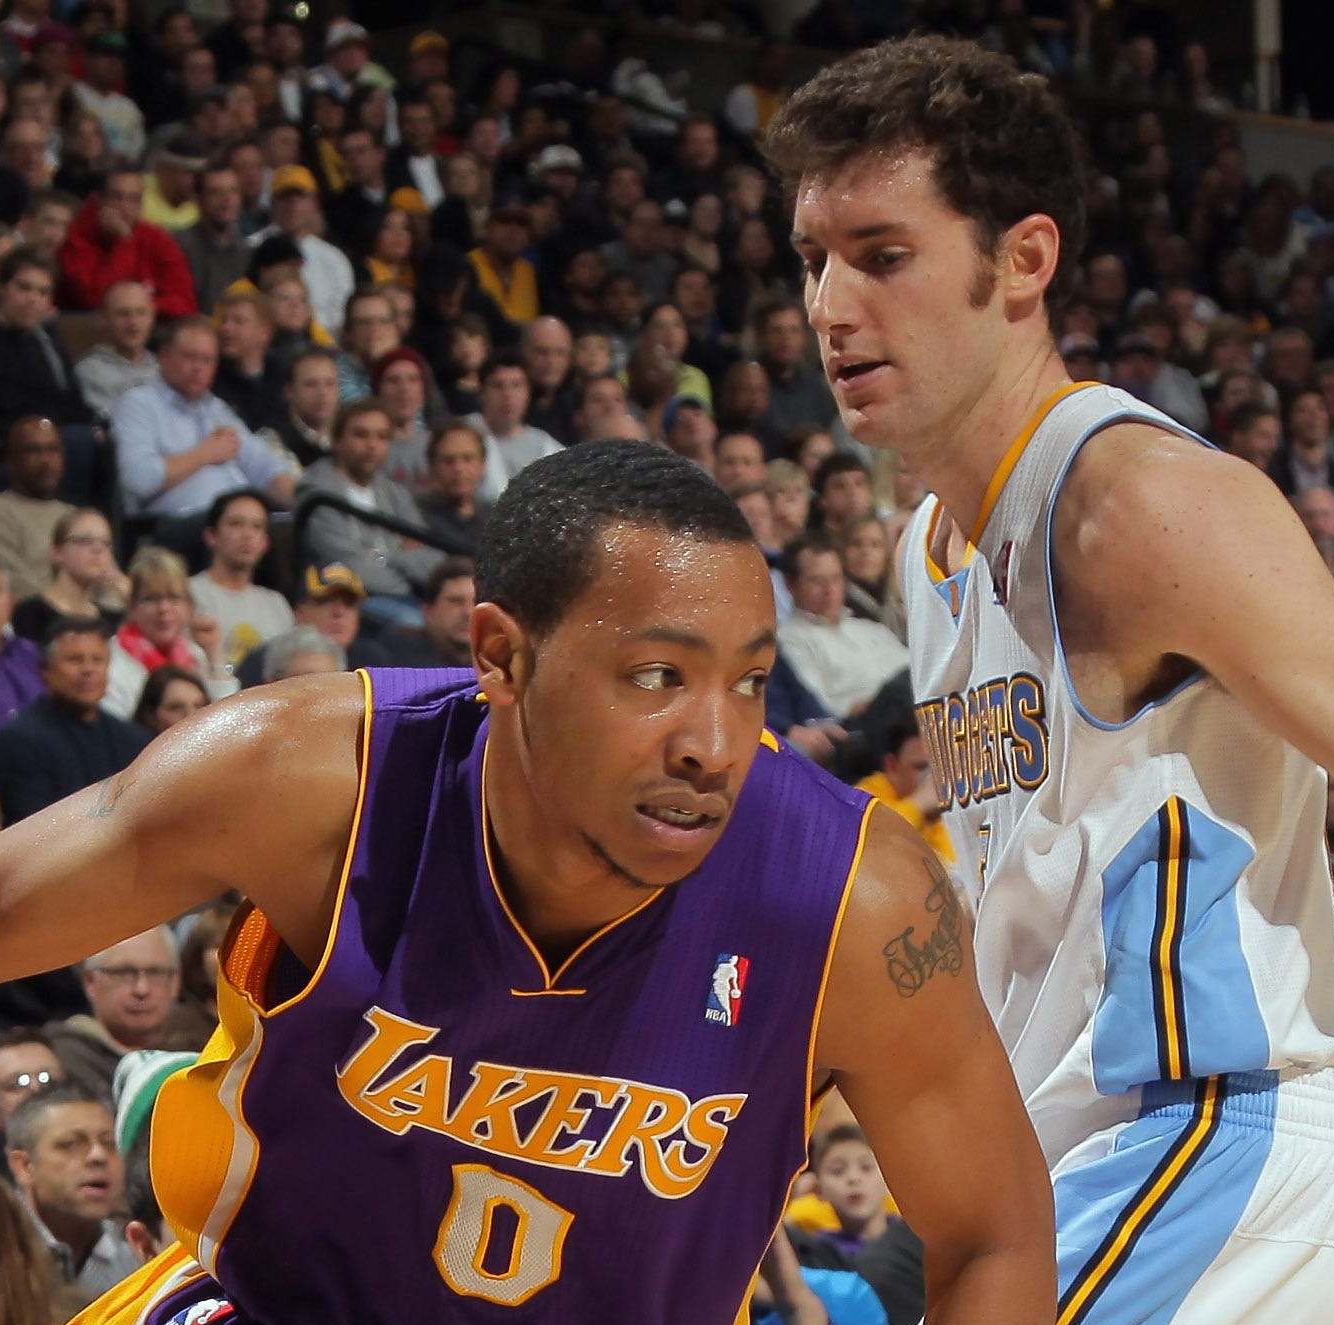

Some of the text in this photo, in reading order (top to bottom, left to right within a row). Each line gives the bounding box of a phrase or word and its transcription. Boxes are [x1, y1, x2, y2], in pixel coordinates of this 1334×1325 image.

[705, 1008, 728, 1024] NBA
[334, 1005, 748, 1199] LAKERS
[432, 1163, 575, 1307] 0
